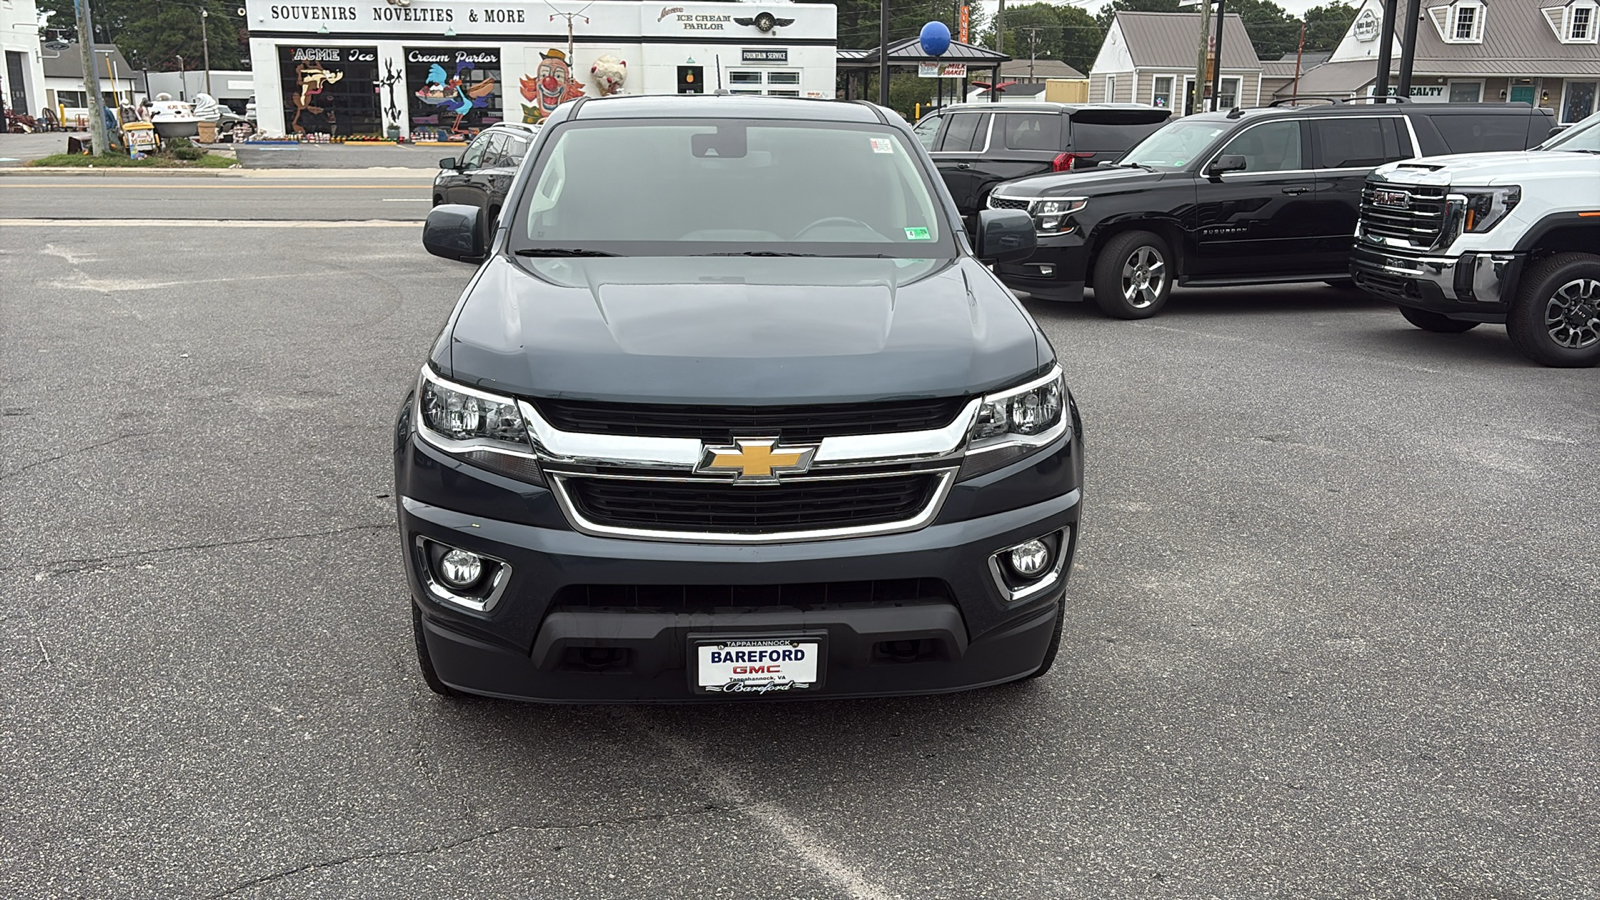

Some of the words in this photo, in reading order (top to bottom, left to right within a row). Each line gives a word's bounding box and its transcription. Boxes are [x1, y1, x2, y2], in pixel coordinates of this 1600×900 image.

[271, 6, 357, 20] SOUVENIRS
[373, 8, 453, 22] NOVELTIES
[468, 9, 478, 23] &
[484, 10, 525, 23] MORE
[294, 48, 340, 61] ACME
[348, 49, 375, 61] Ice
[408, 50, 450, 62] Cream
[455, 51, 498, 63] Parlor
[743, 52, 767, 60] FOUNTAIN
[1409, 87, 1443, 97] EALTY
[711, 649, 805, 663] BAREFORD
[733, 665, 781, 674] GMC
[723, 680, 794, 694] Bareford
